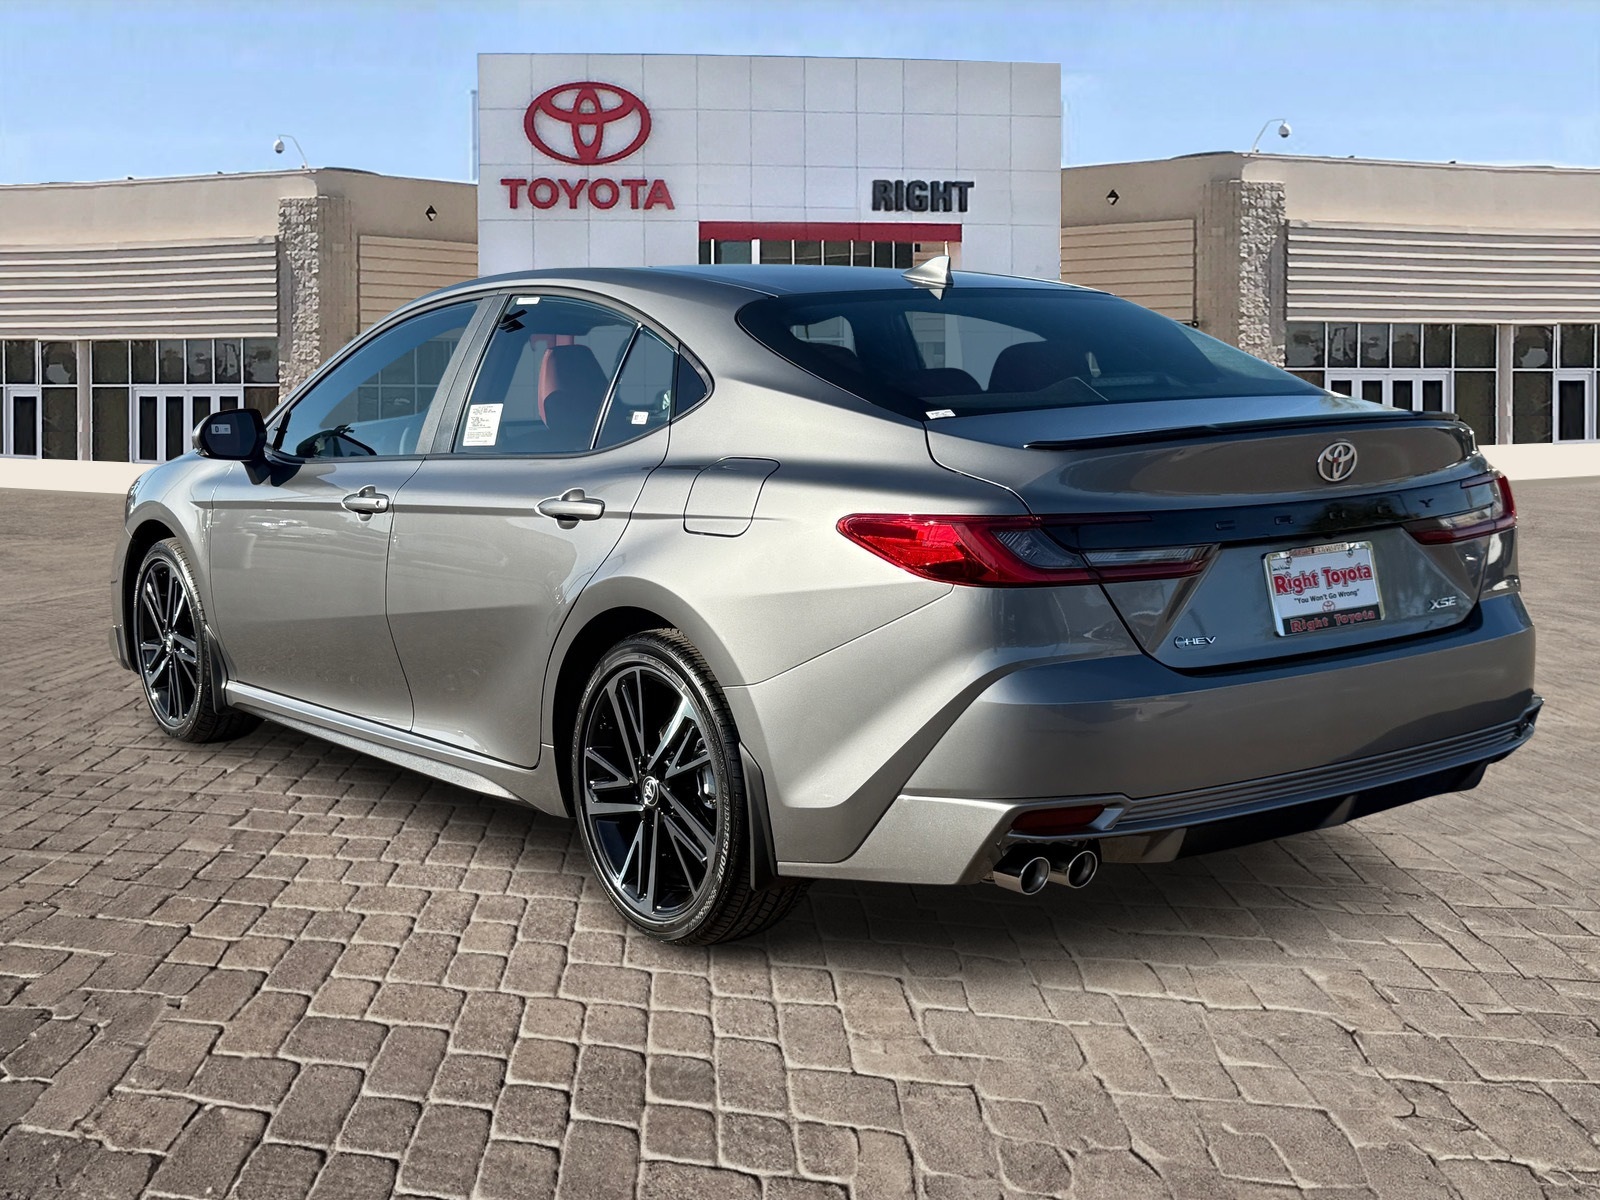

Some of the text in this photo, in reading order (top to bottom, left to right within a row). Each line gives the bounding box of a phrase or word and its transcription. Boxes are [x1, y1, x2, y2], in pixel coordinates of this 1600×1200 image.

[500, 178, 675, 210] TOYOTA
[871, 180, 975, 212] RIGHT
[1272, 563, 1373, 596] Right Toyota
[1310, 593, 1328, 602] Won't
[1328, 591, 1338, 599] Go
[1338, 588, 1360, 598] Wrong"
[1430, 596, 1457, 610] XSE
[1290, 609, 1375, 633] Right Toyota
